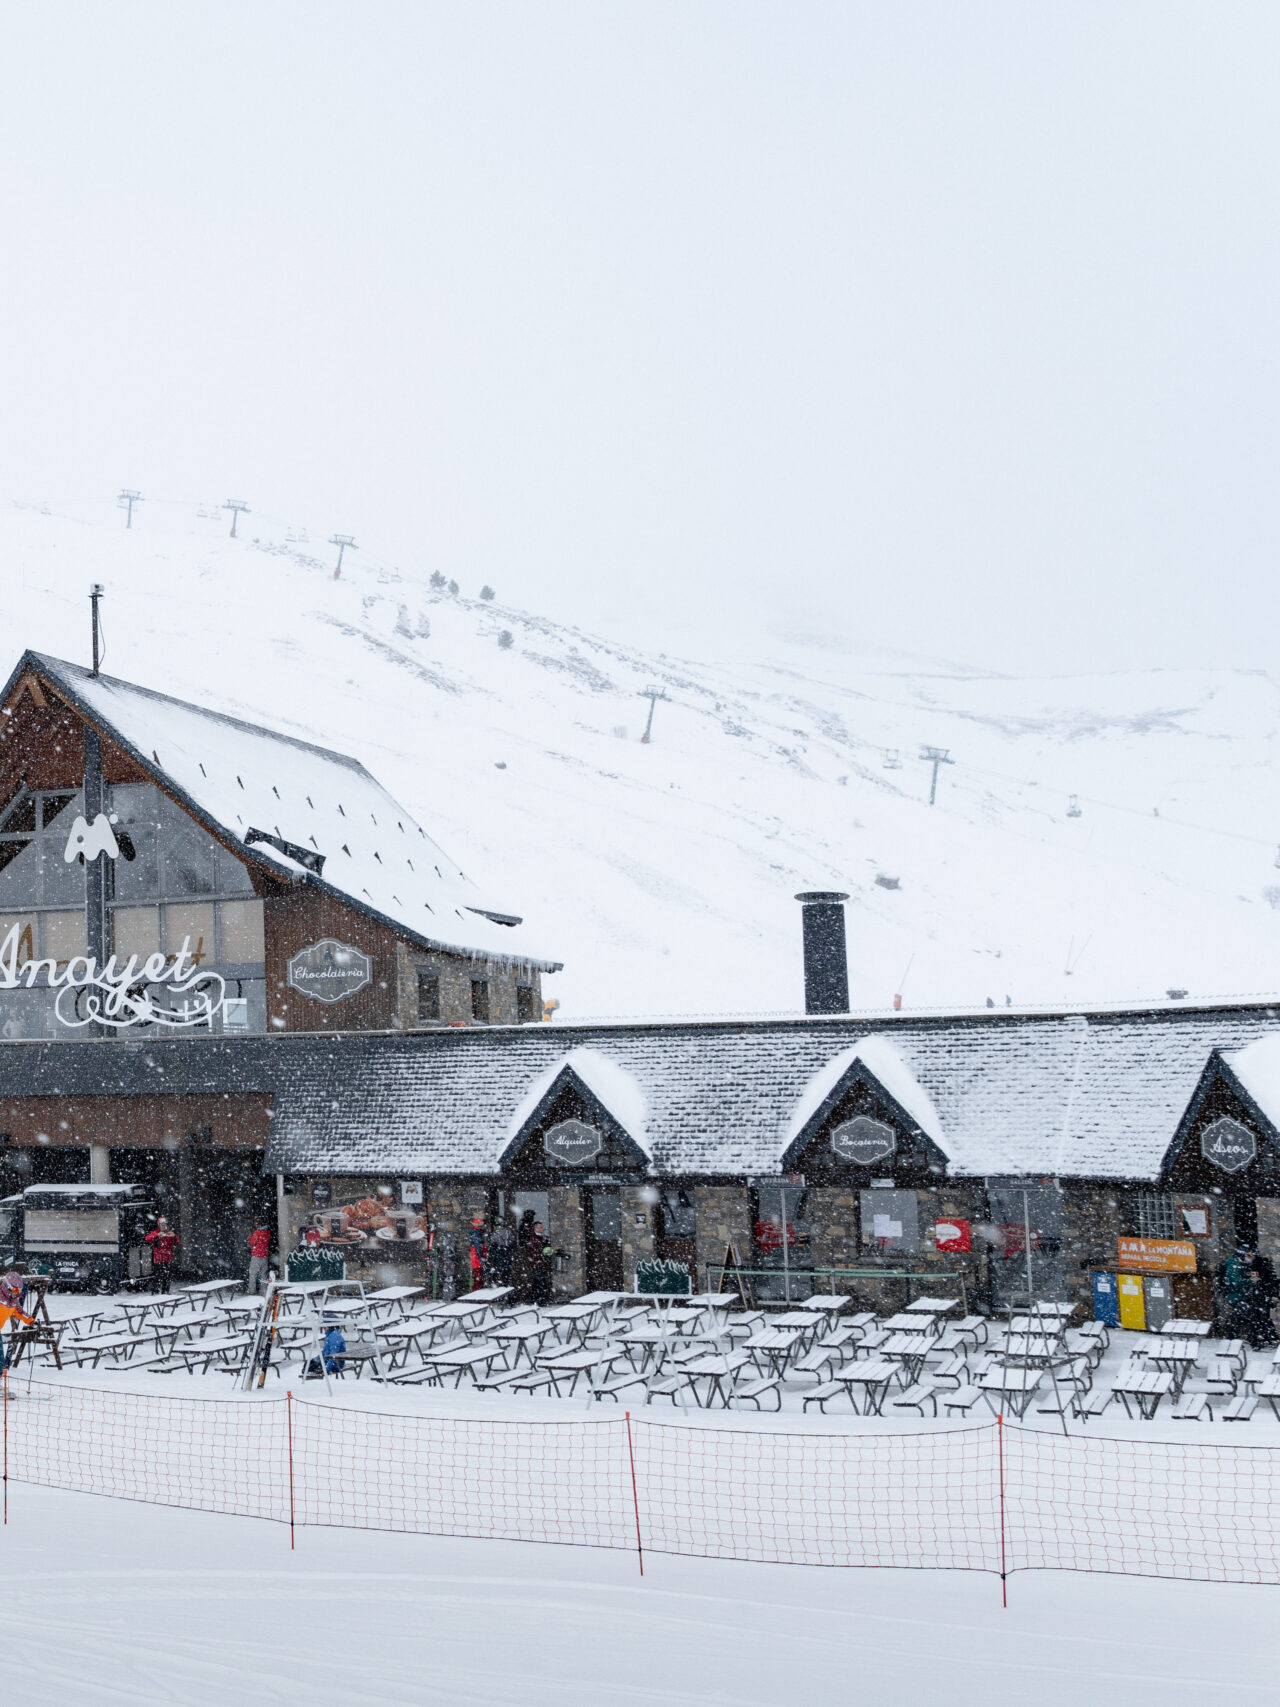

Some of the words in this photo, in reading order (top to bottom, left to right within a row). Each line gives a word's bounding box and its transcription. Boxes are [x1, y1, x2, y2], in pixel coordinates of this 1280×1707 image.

[553, 1135, 592, 1149] Alquiler
[1210, 1134, 1249, 1154] Aseos
[1156, 1245, 1194, 1257] MONTAÑA
